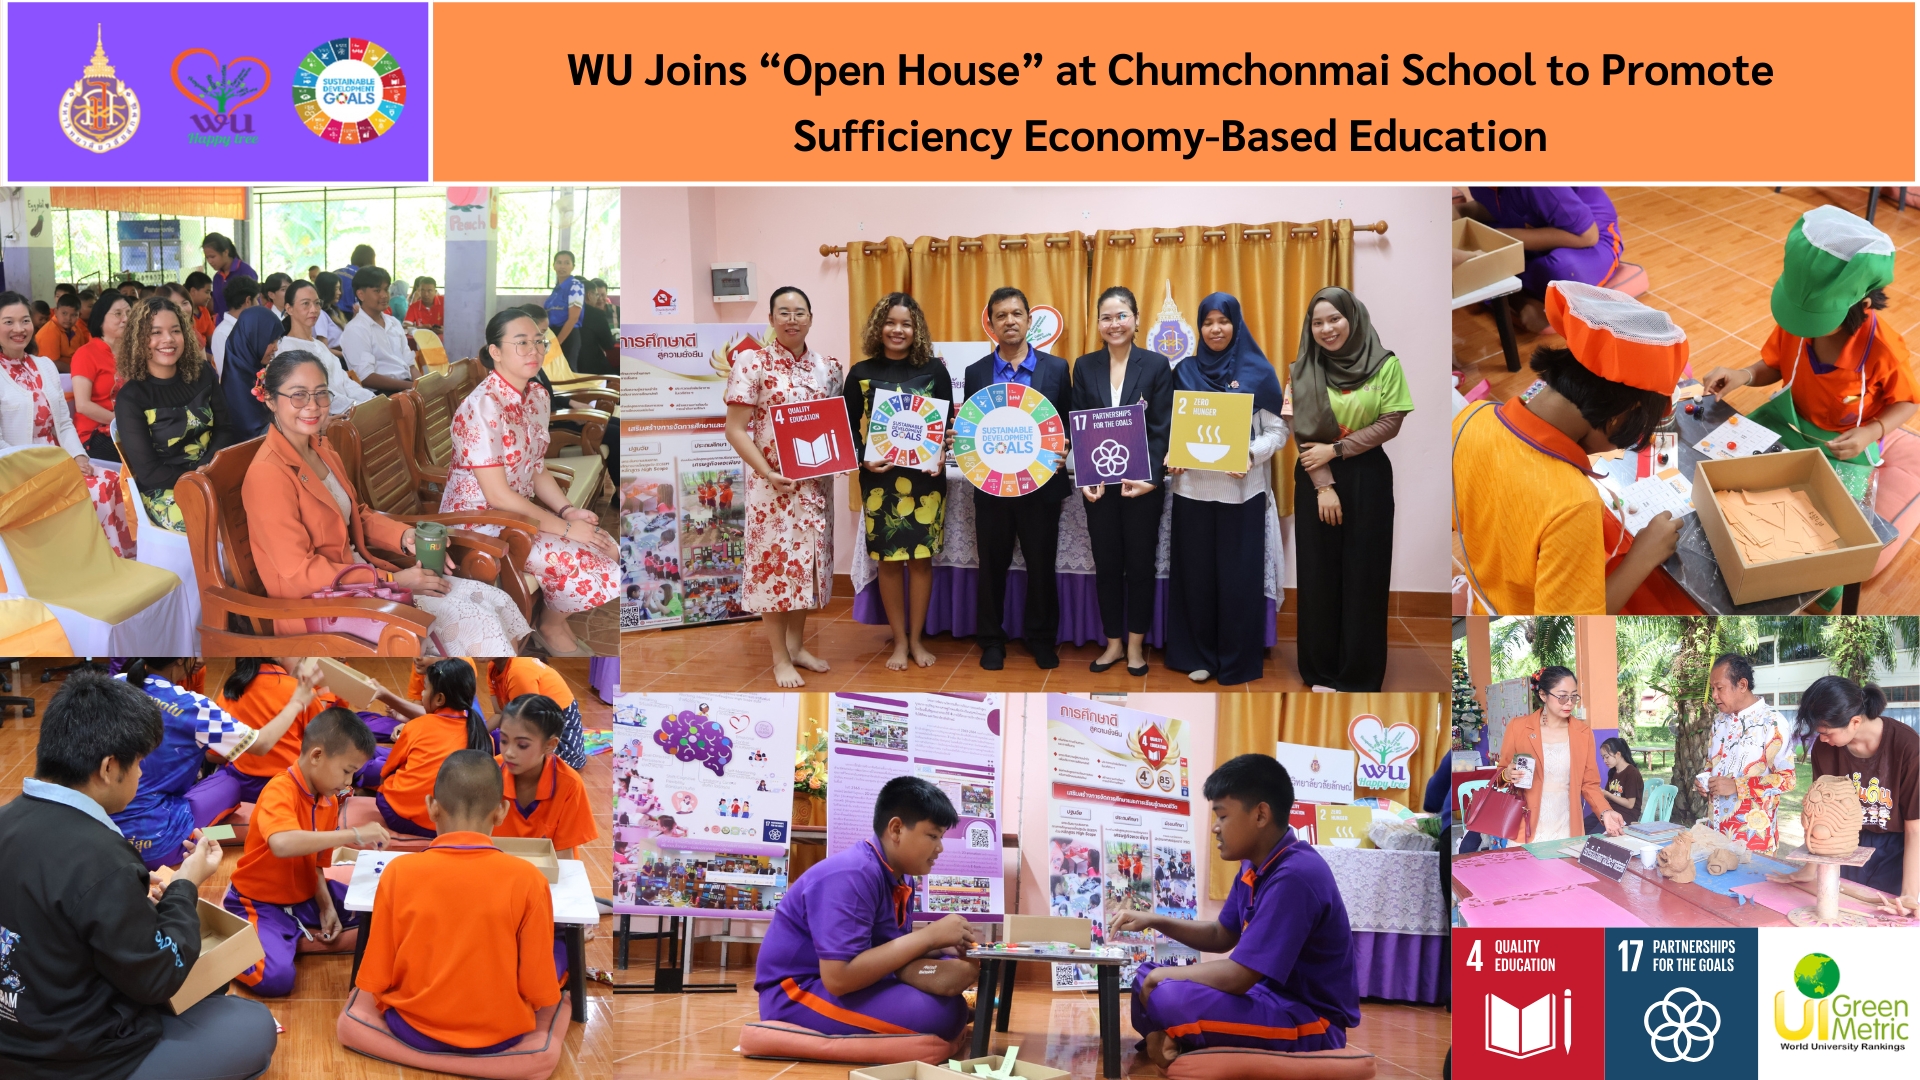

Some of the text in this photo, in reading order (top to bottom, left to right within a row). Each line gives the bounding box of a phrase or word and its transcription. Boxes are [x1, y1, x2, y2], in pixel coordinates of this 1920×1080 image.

[449, 214, 487, 231] Peach
[1178, 397, 1188, 415] 2
[1193, 398, 1210, 406] ZERO
[787, 405, 811, 415] QUALITY
[1092, 410, 1132, 420] PARTNERSHIPS
[1192, 407, 1217, 416] HUNGER
[775, 409, 785, 425] 4
[789, 413, 820, 424] EDUCATION
[1072, 414, 1087, 431] 17
[891, 425, 923, 434] DEVELOPMENT
[892, 420, 924, 430] SUSTAINABLE
[1093, 419, 1133, 429] FOR THE GOALS
[891, 429, 922, 442] GOALS
[981, 426, 1034, 434] SUSTAINABLE
[982, 434, 1033, 442] DEVELOPMENT
[982, 441, 1034, 455] GOALS
[1060, 705, 1118, 727] การศึกษาดี
[1142, 735, 1148, 746] 4
[1358, 777, 1408, 790] Happy tree
[1320, 808, 1327, 821] 2
